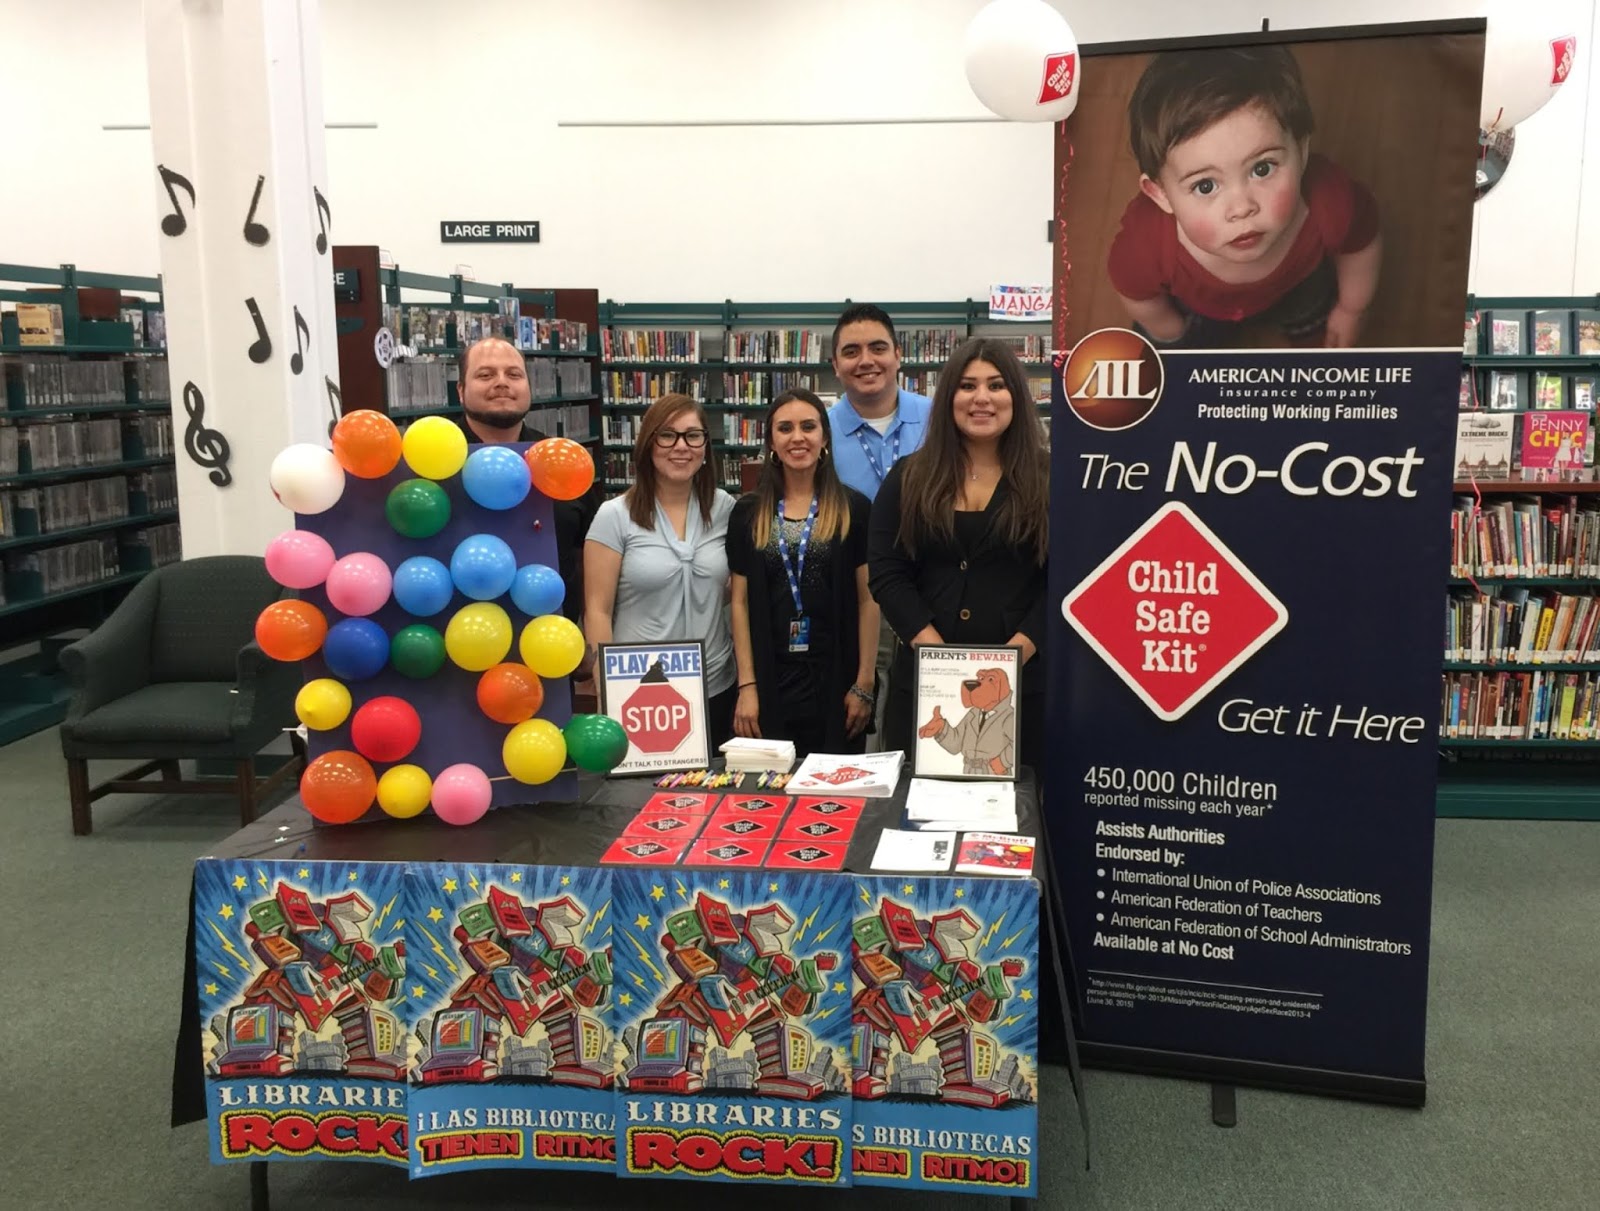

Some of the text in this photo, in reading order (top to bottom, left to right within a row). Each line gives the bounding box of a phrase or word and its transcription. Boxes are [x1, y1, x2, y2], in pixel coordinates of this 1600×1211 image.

[444, 224, 536, 238] LARGE PRINT
[1188, 367, 1412, 384] AMERICAN INCOME LIFE
[1220, 386, 1378, 400] insurance company
[1198, 404, 1398, 422] Protecting Working Families
[1532, 419, 1584, 431] PENNY
[1078, 440, 1425, 498] The No-Cost
[1128, 560, 1220, 596] Child
[1135, 600, 1211, 635] Safe
[606, 652, 700, 675] PLAY SAFE
[920, 651, 1014, 662] PARENTS BEWARE
[626, 705, 687, 733] STOP
[1217, 698, 1425, 744] Get it Here
[1083, 766, 1278, 801] 450,000 Children
[1084, 792, 1140, 808] reported
[1144, 794, 1196, 814] missing
[1200, 799, 1232, 815] each
[1095, 820, 1226, 846] Assists Authorities
[1096, 843, 1186, 868] Endorsed by:
[1112, 868, 1382, 906] International Union of Police Associations
[1111, 890, 1324, 924] American Federation of Teachers
[1093, 931, 1235, 961] Available at No Cost
[1110, 912, 1412, 956] American Federation of School Administrators
[626, 1100, 843, 1130] LIBRARIES
[422, 1132, 520, 1161] TIENEN
[631, 1131, 835, 1177] ROCK!
[873, 1126, 1032, 1156] BIBLIOTECAS
[924, 1155, 1026, 1184] RITMO!
